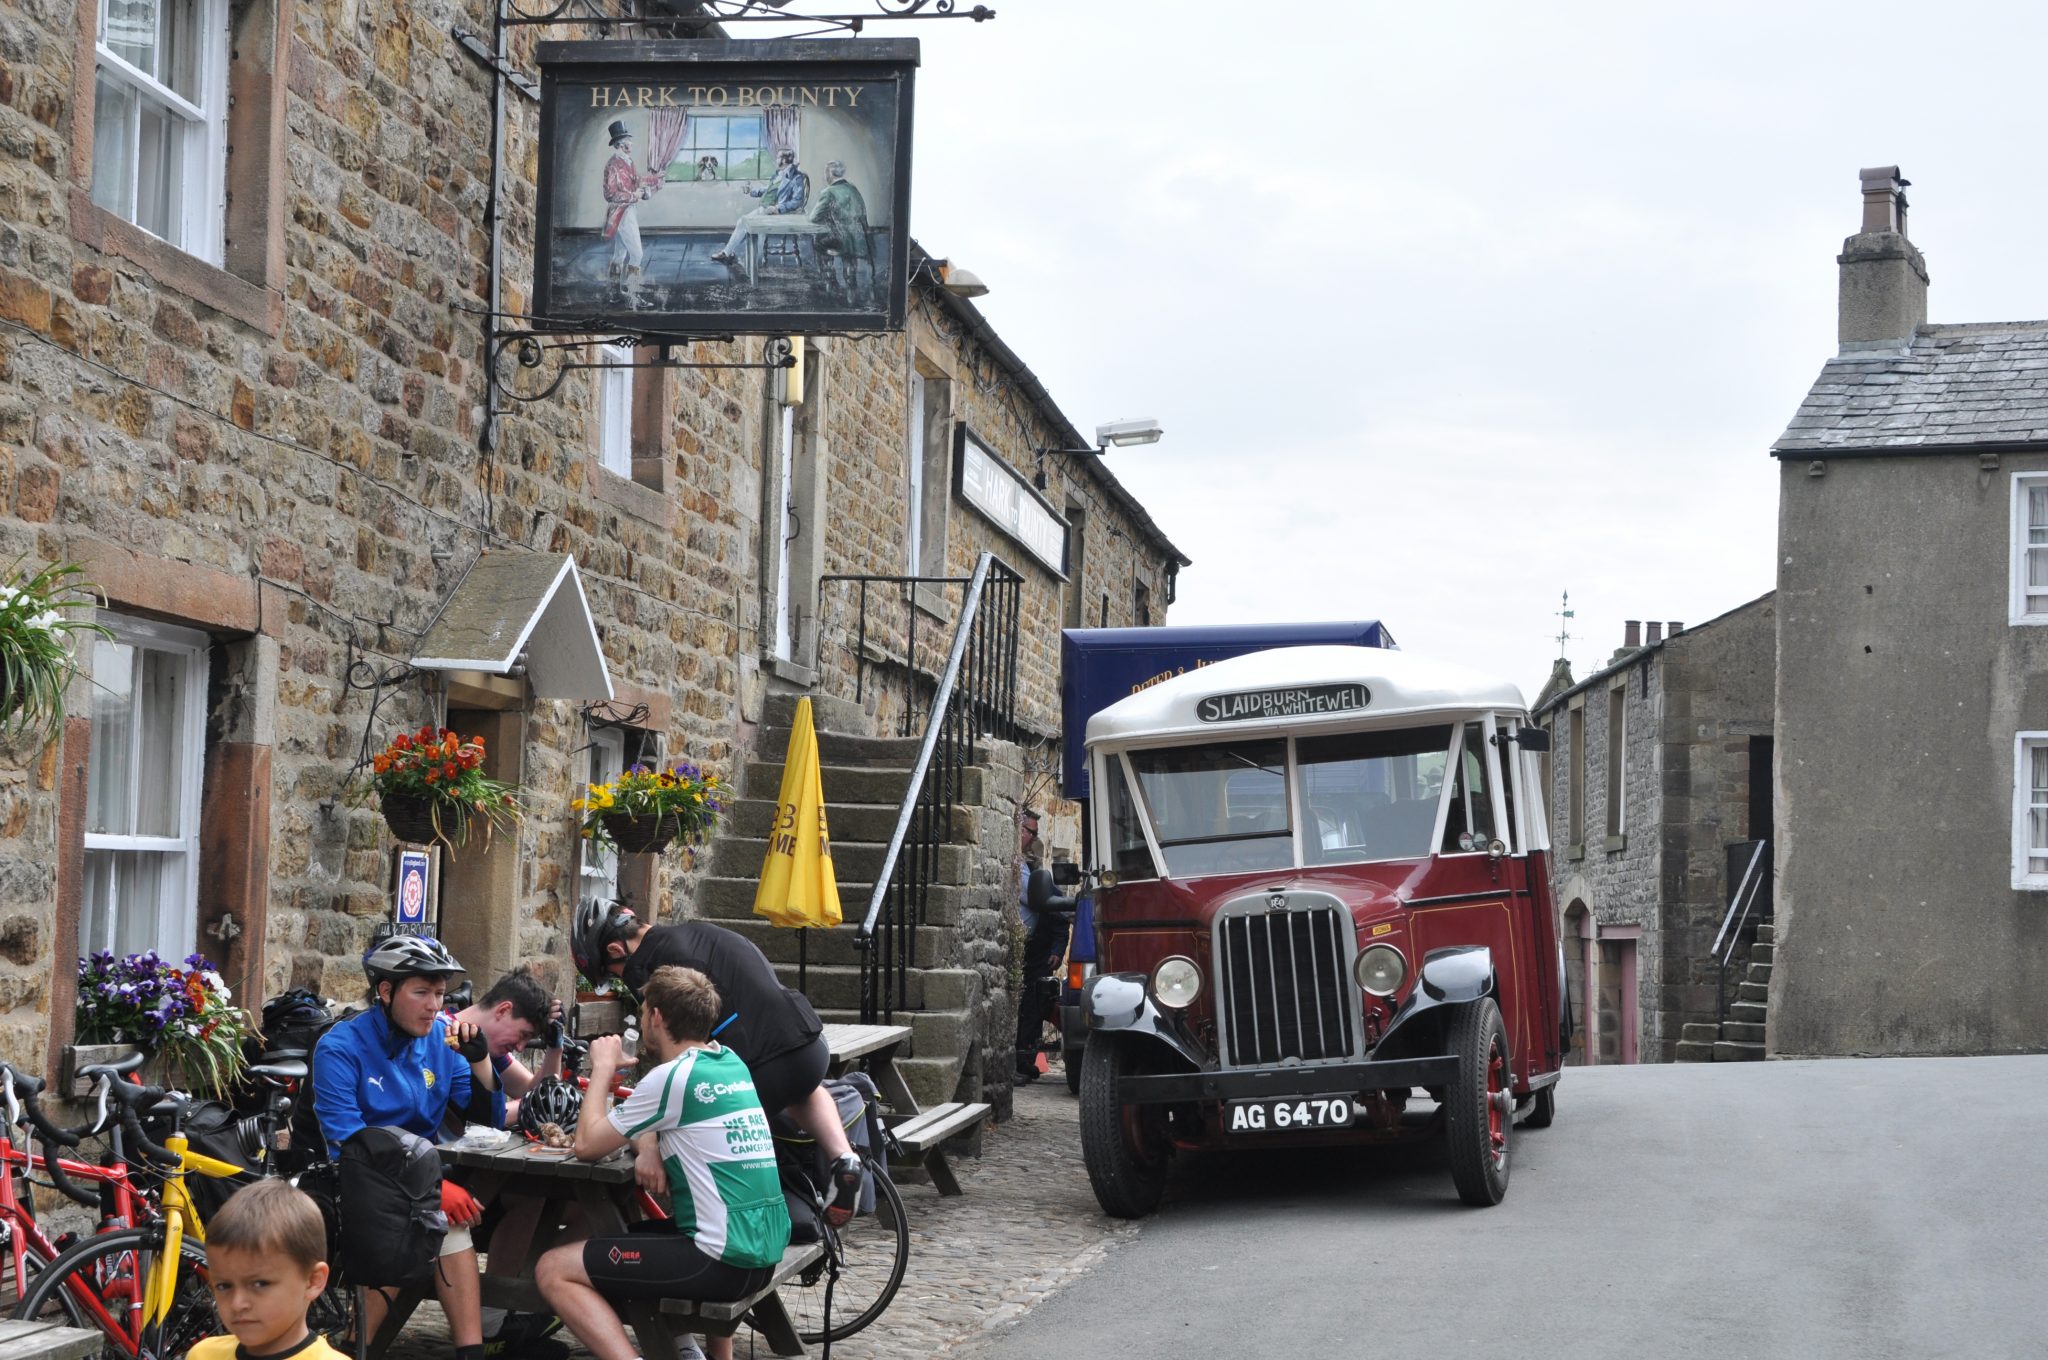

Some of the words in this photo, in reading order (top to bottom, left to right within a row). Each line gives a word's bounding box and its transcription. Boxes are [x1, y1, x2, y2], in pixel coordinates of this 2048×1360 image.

[591, 87, 678, 107] HARK
[688, 86, 728, 107] TO
[738, 86, 865, 107] BOUNTY
[984, 467, 1011, 519] HARK
[1019, 495, 1048, 557] BOUNTY
[1205, 689, 1310, 721] SLAIDBURN
[1263, 707, 1280, 718] VIA
[723, 1116, 748, 1130] WE
[747, 1113, 765, 1127] ARE
[1231, 1104, 1266, 1130] AG
[1273, 1099, 1349, 1127] 6470
